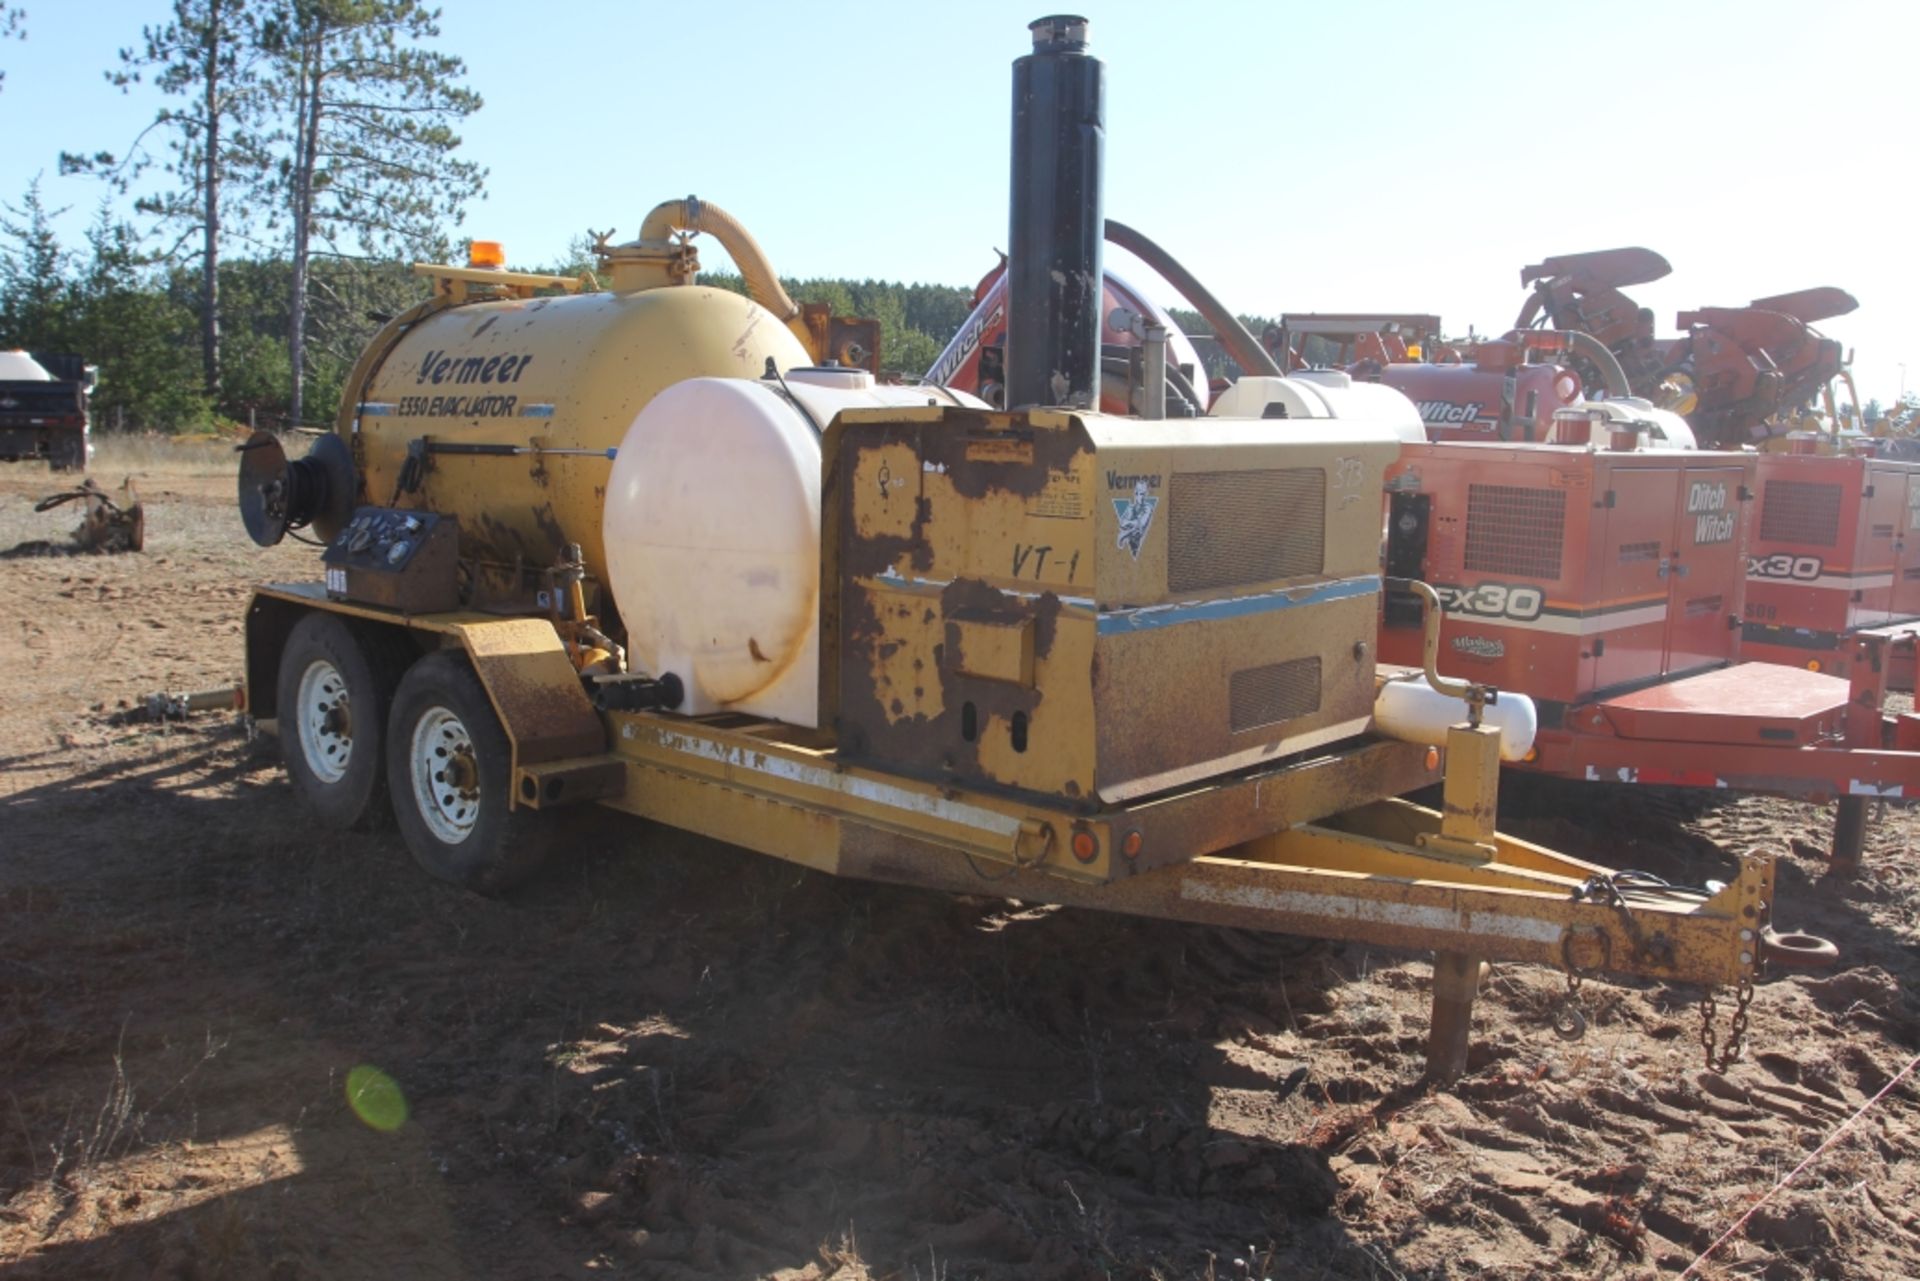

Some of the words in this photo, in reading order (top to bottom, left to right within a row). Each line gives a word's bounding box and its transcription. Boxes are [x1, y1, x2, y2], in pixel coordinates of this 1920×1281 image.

[416, 350, 534, 385] Vermeer
[428, 396, 517, 418] EVACUATOR
[1416, 400, 1480, 422] Witch
[1687, 482, 1727, 512] Ditch
[1695, 512, 1734, 543] Witch
[1012, 543, 1080, 583] VT-1
[1747, 555, 1821, 579] X30
